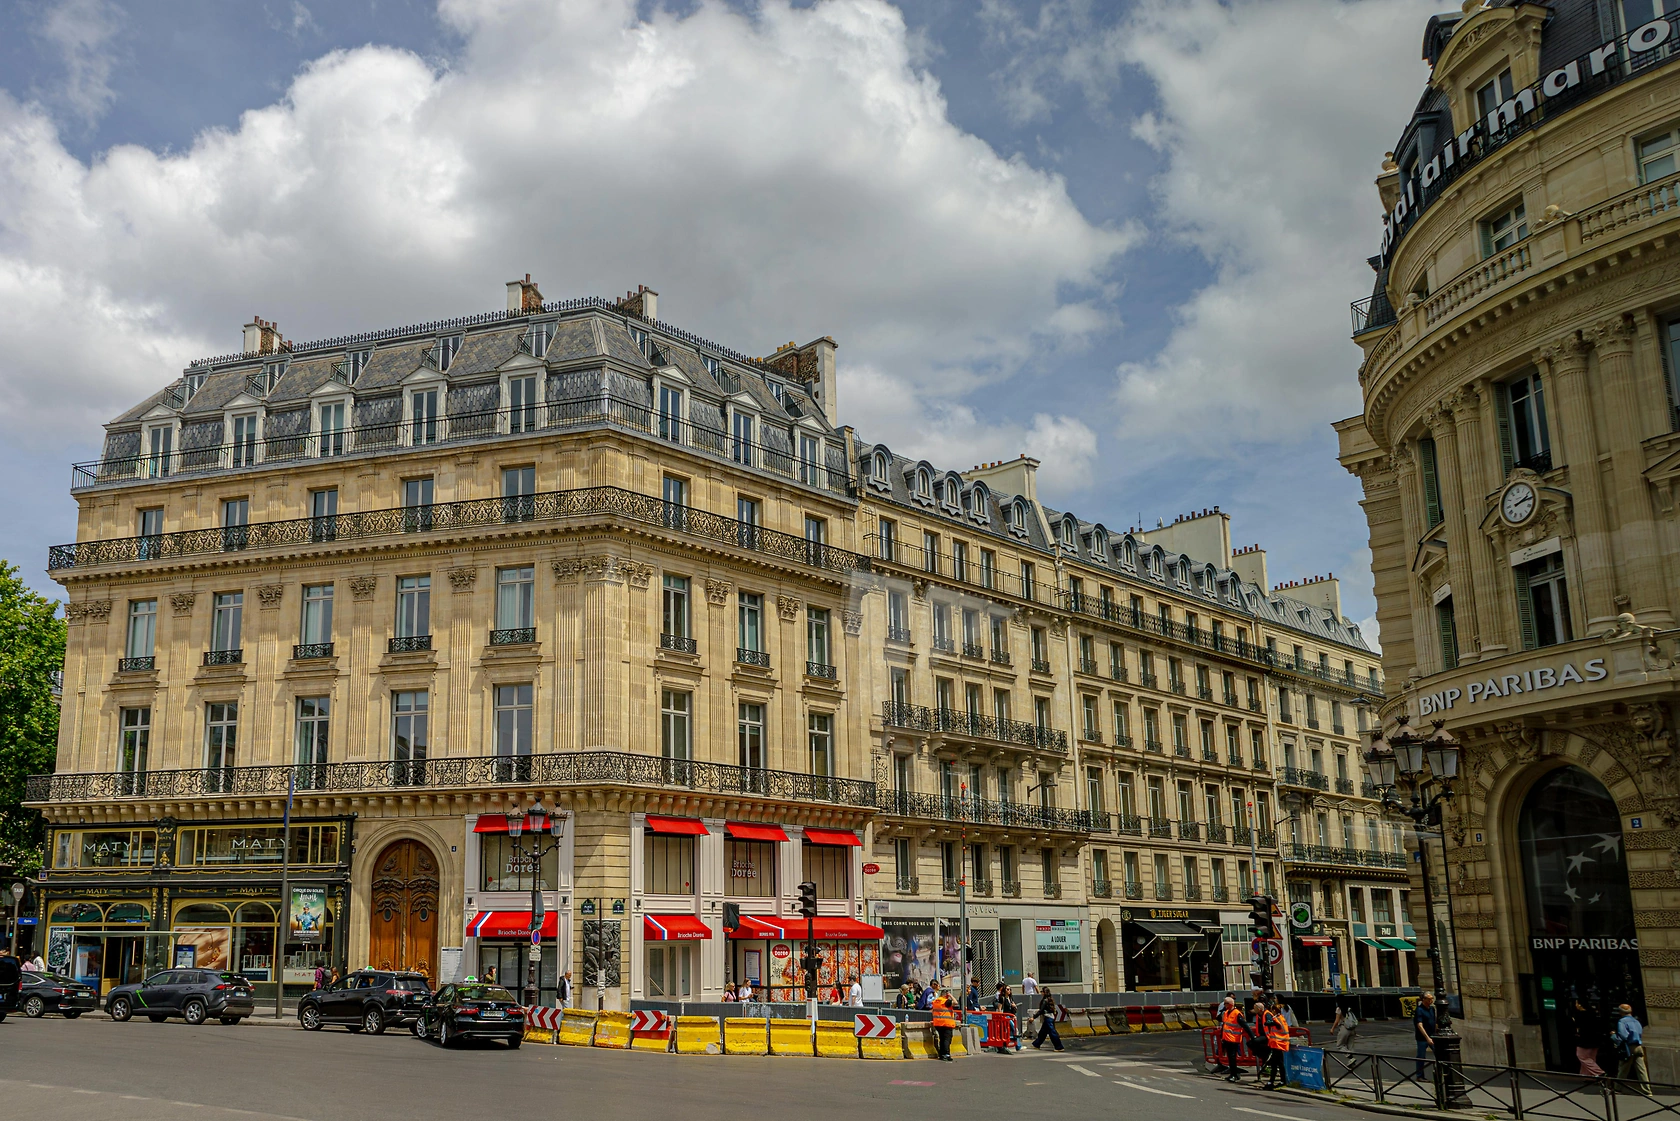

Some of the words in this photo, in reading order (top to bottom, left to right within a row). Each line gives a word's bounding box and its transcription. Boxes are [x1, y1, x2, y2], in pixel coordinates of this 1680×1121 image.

[1421, 125, 1476, 188] air
[1419, 687, 1462, 717] BNP
[1466, 657, 1609, 704] PARIBAS
[83, 841, 132, 853] MATY
[232, 838, 290, 849] MATY
[733, 860, 755, 868] Brioche
[731, 867, 757, 878] Dorée
[1157, 910, 1172, 918] TIGER
[1173, 910, 1189, 918] SUGAR
[1533, 938, 1565, 949] BNP
[1569, 938, 1639, 950] PARIBAS
